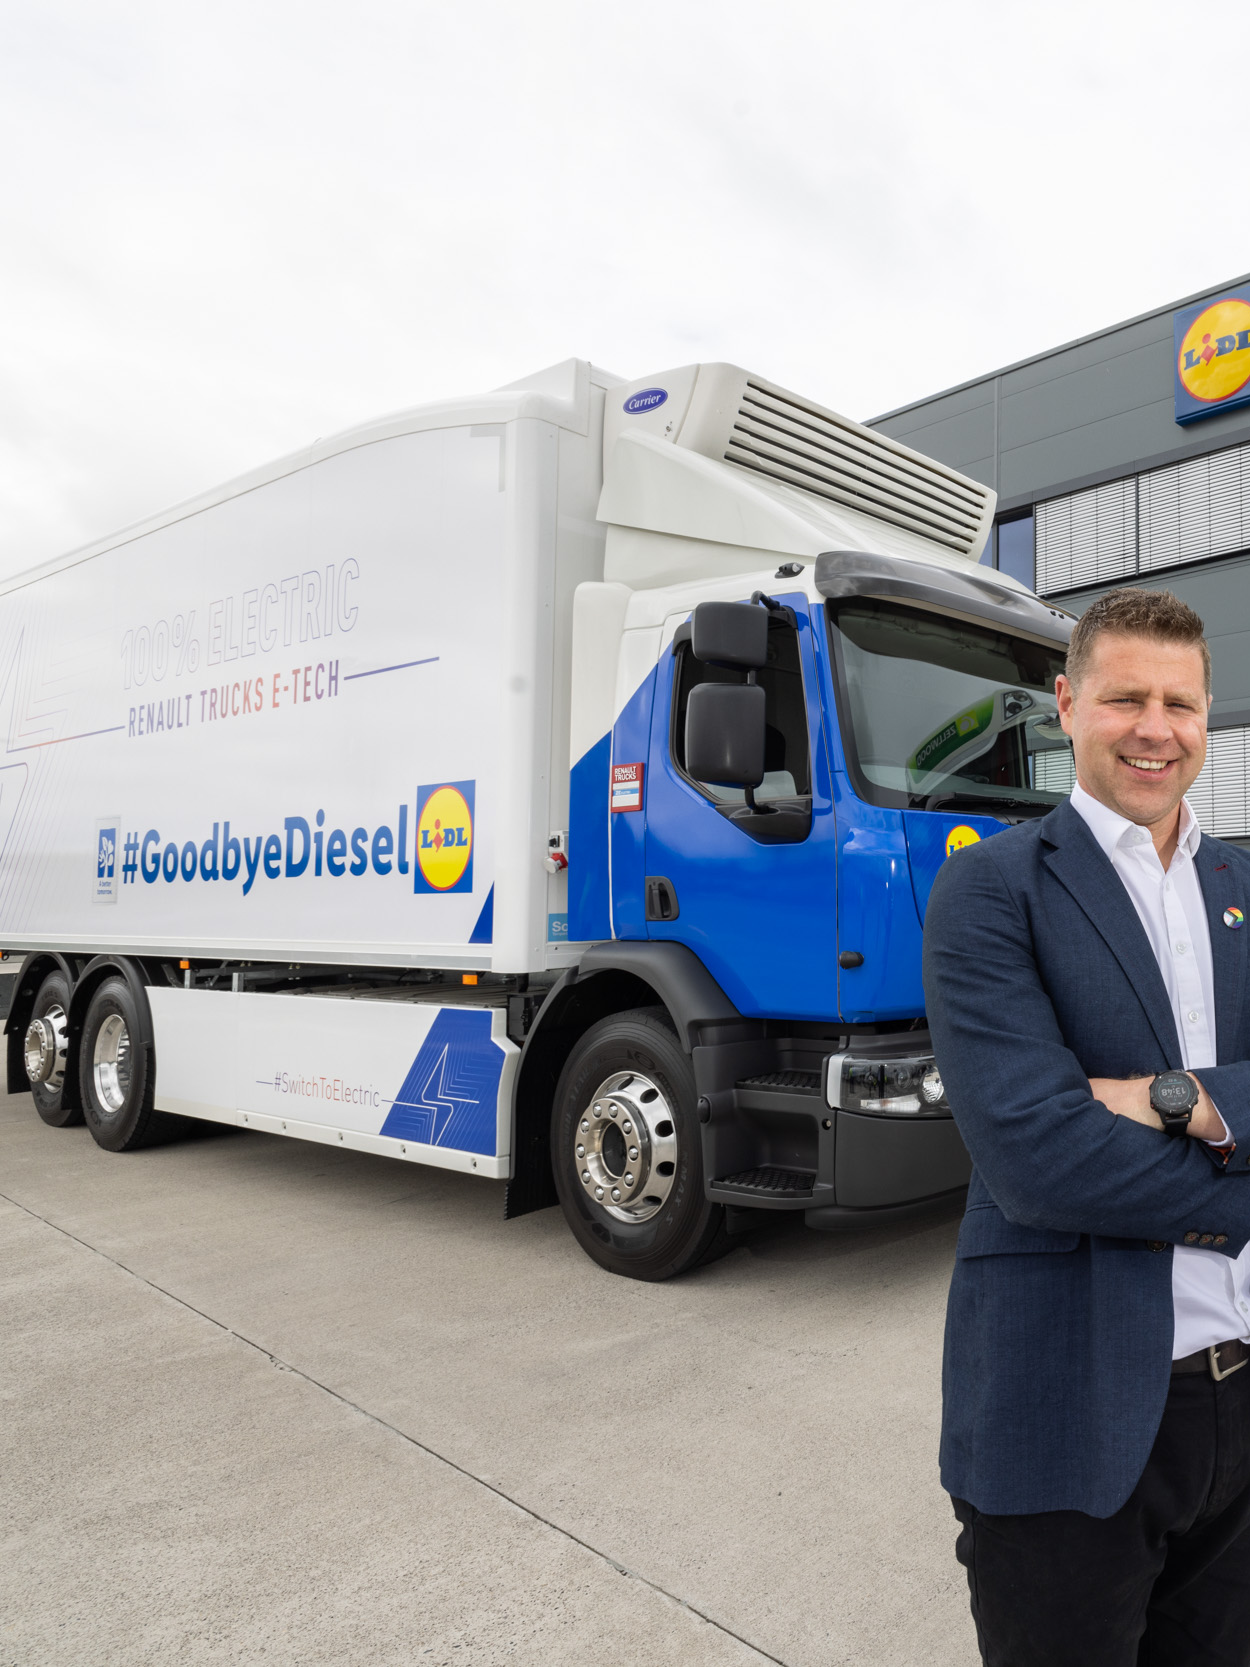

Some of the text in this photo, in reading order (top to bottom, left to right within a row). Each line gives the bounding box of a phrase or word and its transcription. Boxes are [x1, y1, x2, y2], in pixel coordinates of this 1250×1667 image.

[628, 394, 662, 410] Carrier
[120, 557, 360, 691] 100% ELECTRIC
[128, 659, 340, 738] RENAULT TRUCKS E-TECH
[615, 766, 636, 775] RENAULT
[615, 773, 636, 781] TRUCKS
[122, 803, 410, 897] #GoodbyeDiesel
[274, 1072, 380, 1108] #SwitchToElectric
[1161, 1087, 1186, 1097] 13:48
